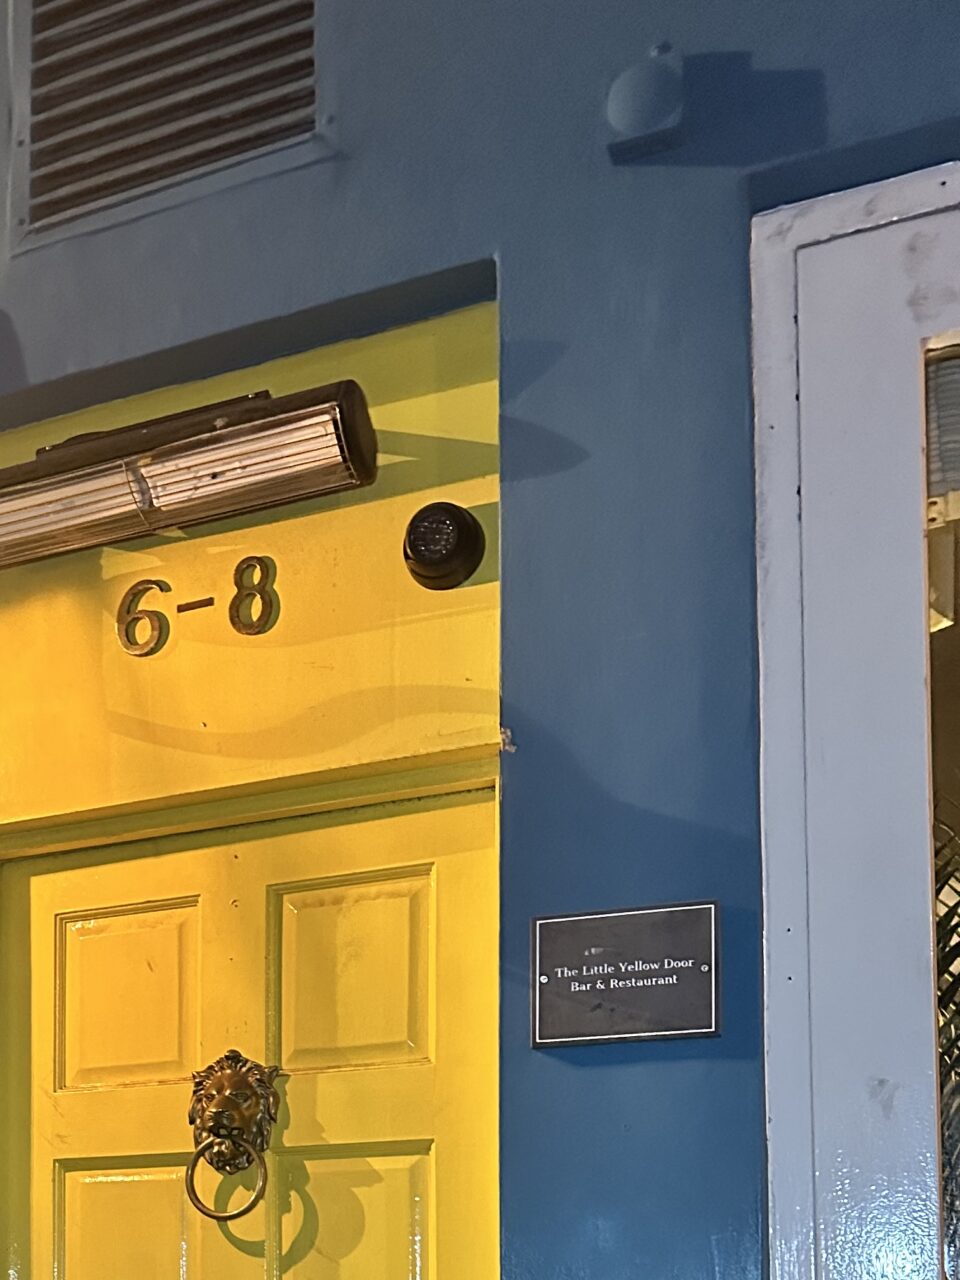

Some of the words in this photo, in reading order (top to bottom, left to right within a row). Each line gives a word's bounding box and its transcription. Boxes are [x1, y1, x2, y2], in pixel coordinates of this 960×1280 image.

[116, 555, 278, 657] 6-8
[554, 967, 579, 978] The
[582, 963, 615, 976] Little
[618, 960, 661, 973] Yellow
[664, 958, 695, 969] Door
[570, 981, 592, 992] Bar
[595, 979, 606, 990] &
[609, 974, 678, 989] Restaurant
